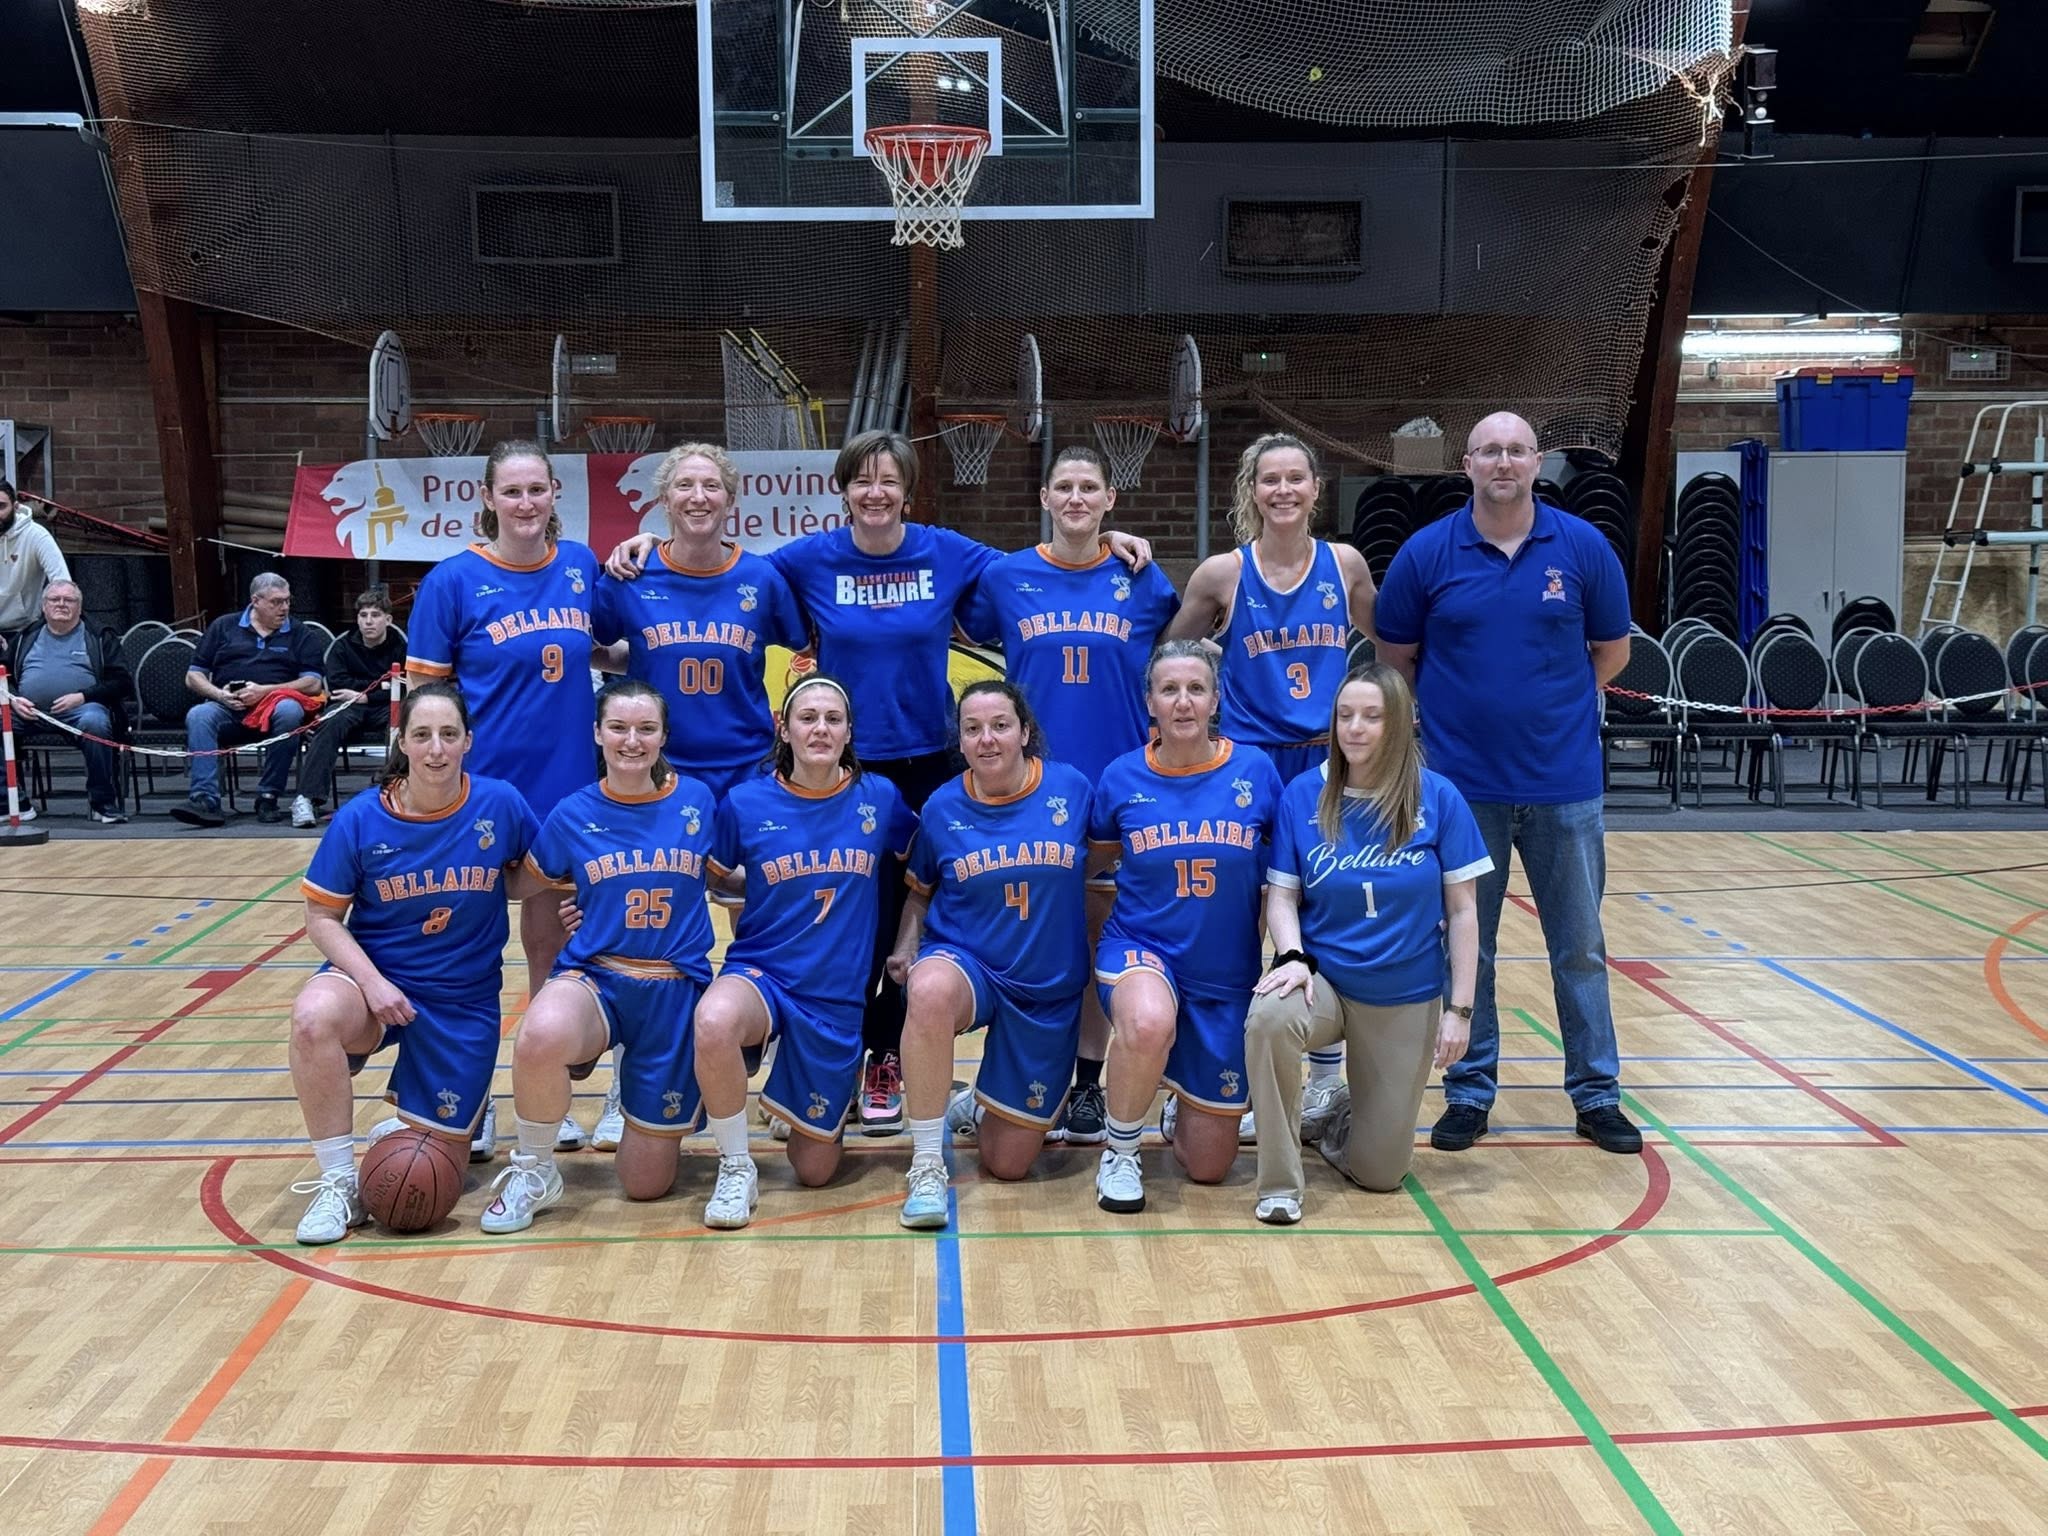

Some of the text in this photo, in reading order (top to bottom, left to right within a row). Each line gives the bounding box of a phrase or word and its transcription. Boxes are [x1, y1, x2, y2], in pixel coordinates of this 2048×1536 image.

[742, 466, 842, 496] rovinc
[421, 512, 463, 538] de
[722, 506, 762, 537] de
[835, 569, 935, 605] BELLAIRE
[642, 621, 757, 654] BELLAIRE
[1018, 611, 1132, 642] BELLAIRE
[541, 644, 564, 683] 9
[679, 657, 724, 695] 00
[1062, 646, 1090, 684] 11
[1286, 662, 1312, 699] 3
[1129, 820, 1255, 854] BELLAIRE
[584, 848, 703, 885] BELLAIRE
[953, 841, 1076, 882] BELLAIRE
[1174, 858, 1217, 897] 15
[1305, 842, 1427, 889] Bellaire
[375, 866, 500, 902] BELLAIRE
[1004, 881, 1029, 921] 4
[1361, 881, 1378, 918] 1
[421, 906, 452, 936] 8
[625, 888, 674, 929] 25
[814, 887, 837, 924] 7
